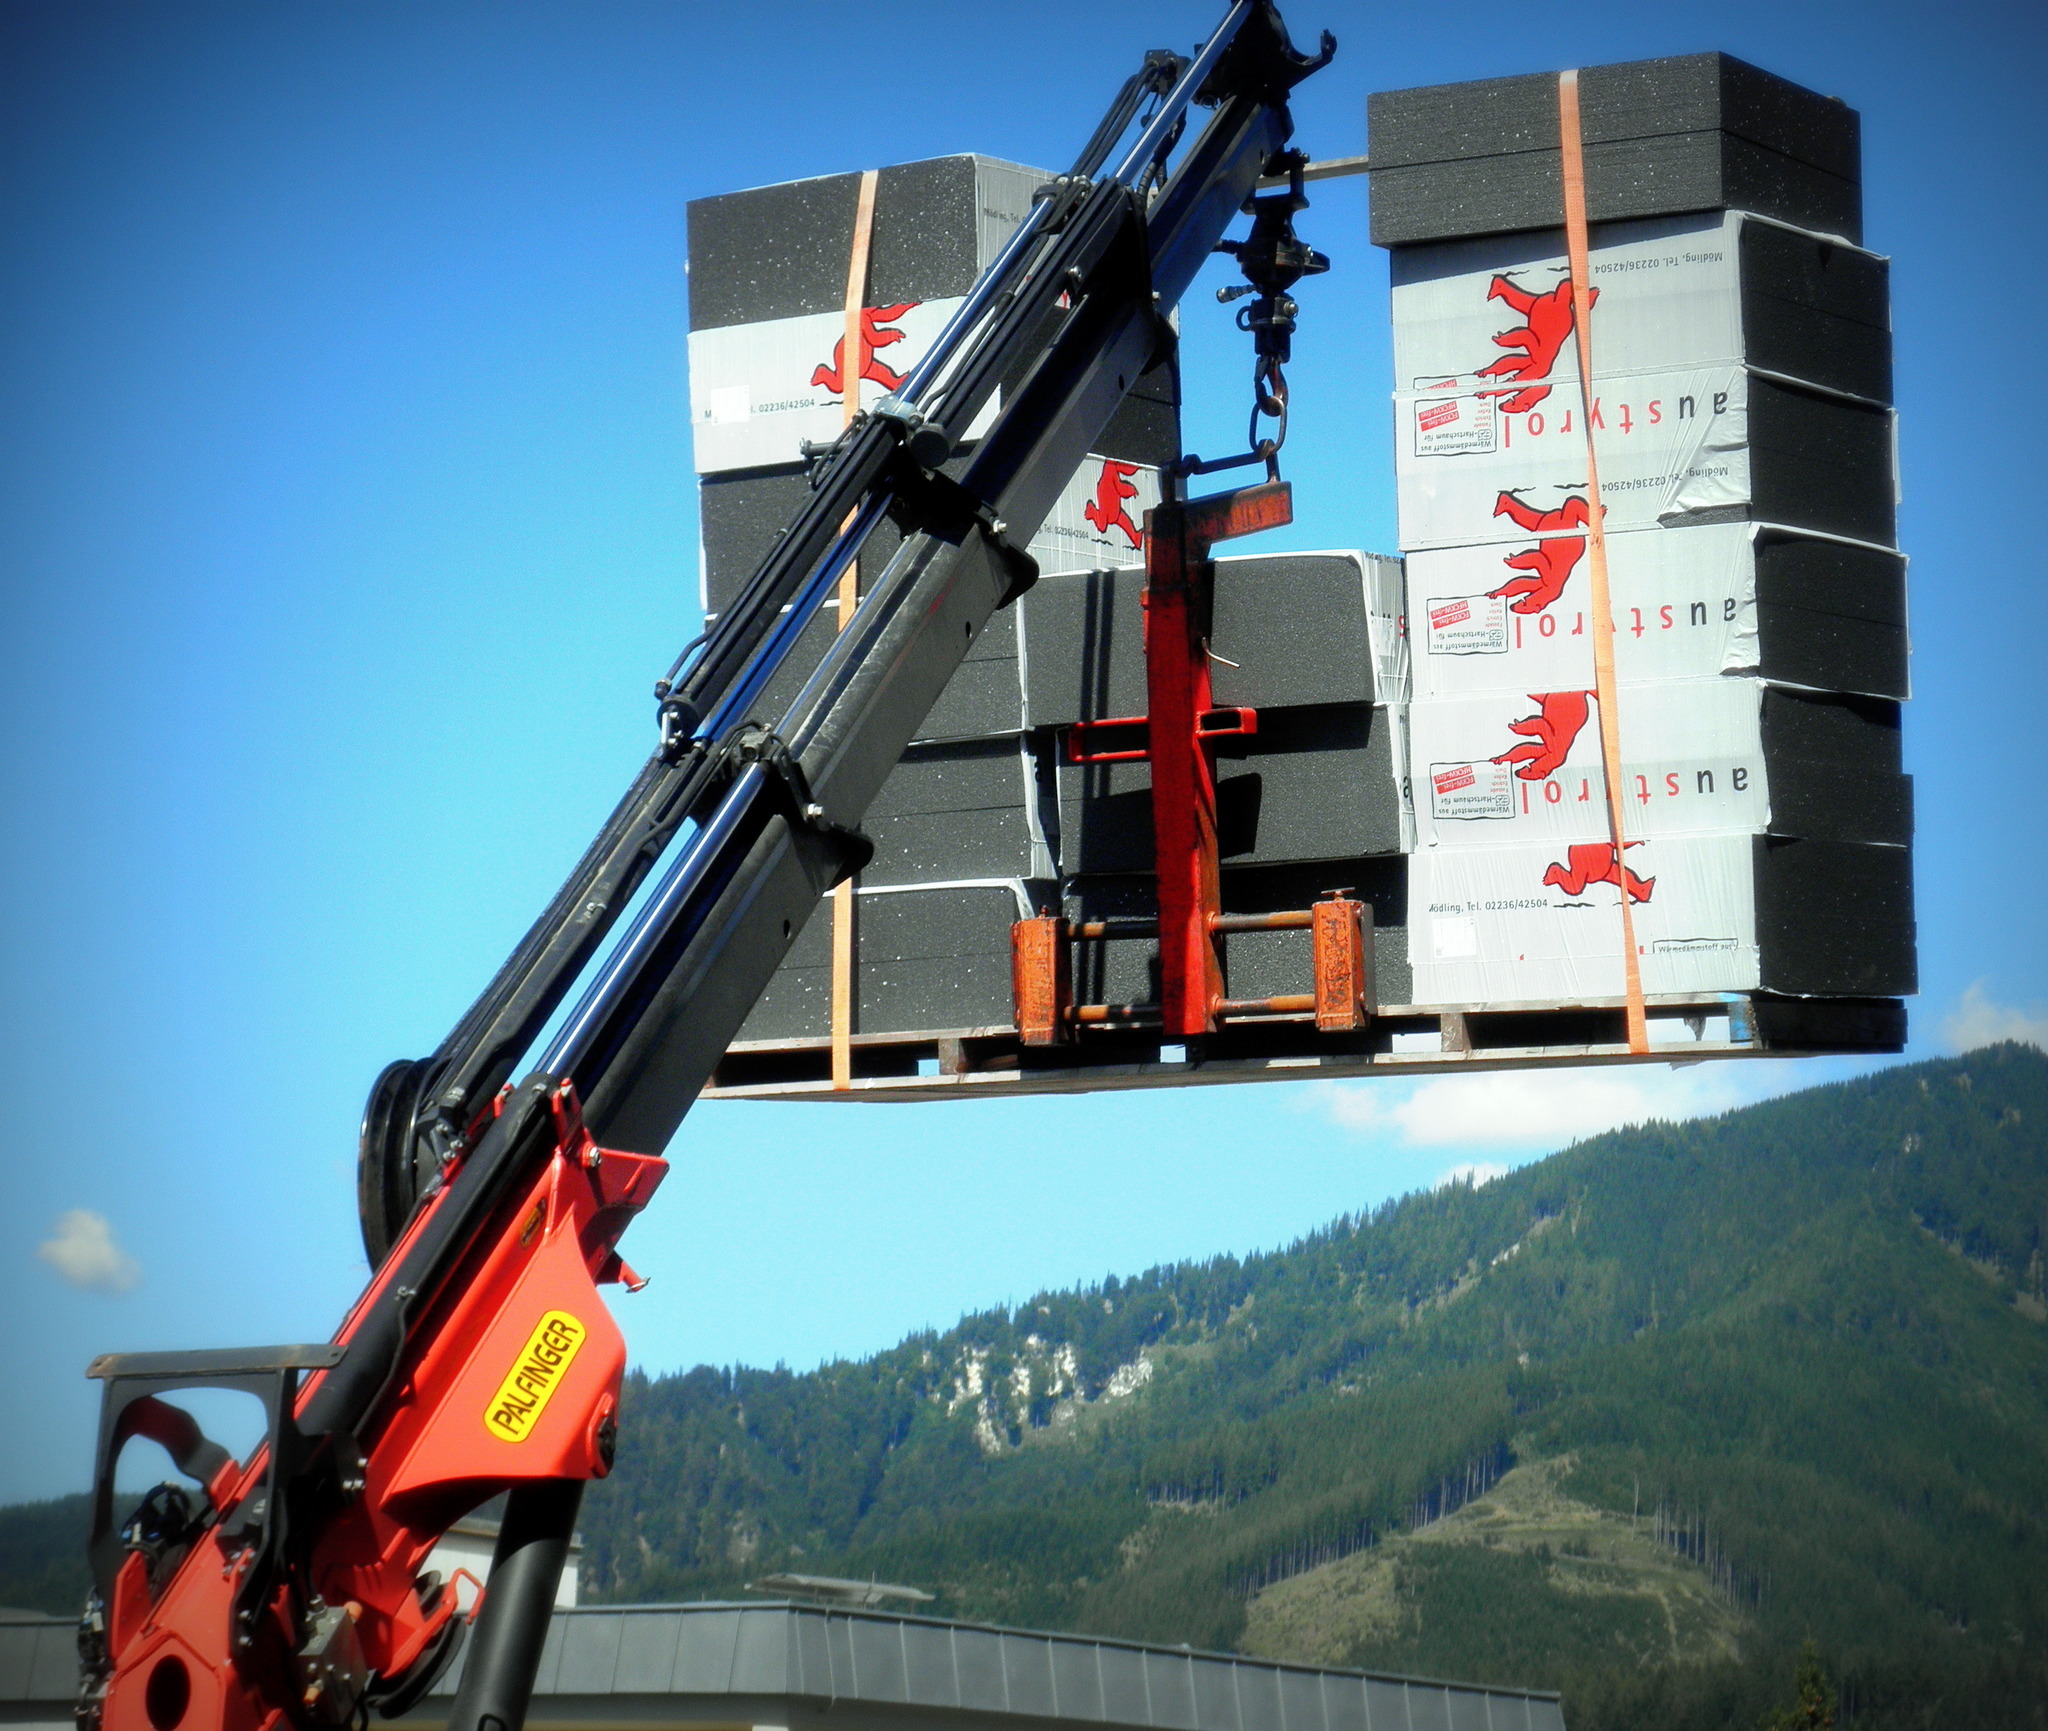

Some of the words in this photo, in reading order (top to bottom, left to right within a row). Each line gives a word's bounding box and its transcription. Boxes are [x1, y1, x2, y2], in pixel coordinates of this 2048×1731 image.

[1663, 257, 1679, 267] Tel.
[1682, 252, 1723, 263] Mödling,
[1595, 259, 1659, 274] 02236/42504
[758, 398, 815, 413] 02236/42504
[1434, 440, 1492, 452] Wärmedämmstoff
[1686, 467, 1728, 478] Mödling,
[1602, 476, 1666, 492] 02236/42504
[1516, 597, 1736, 649] austrol
[1522, 766, 1748, 815] austrol
[1452, 806, 1510, 816] Wärmedämmstoff
[1467, 901, 1481, 911] Tel.
[1485, 899, 1548, 910] 02236/42504
[492, 1319, 578, 1435] PALFINGER
